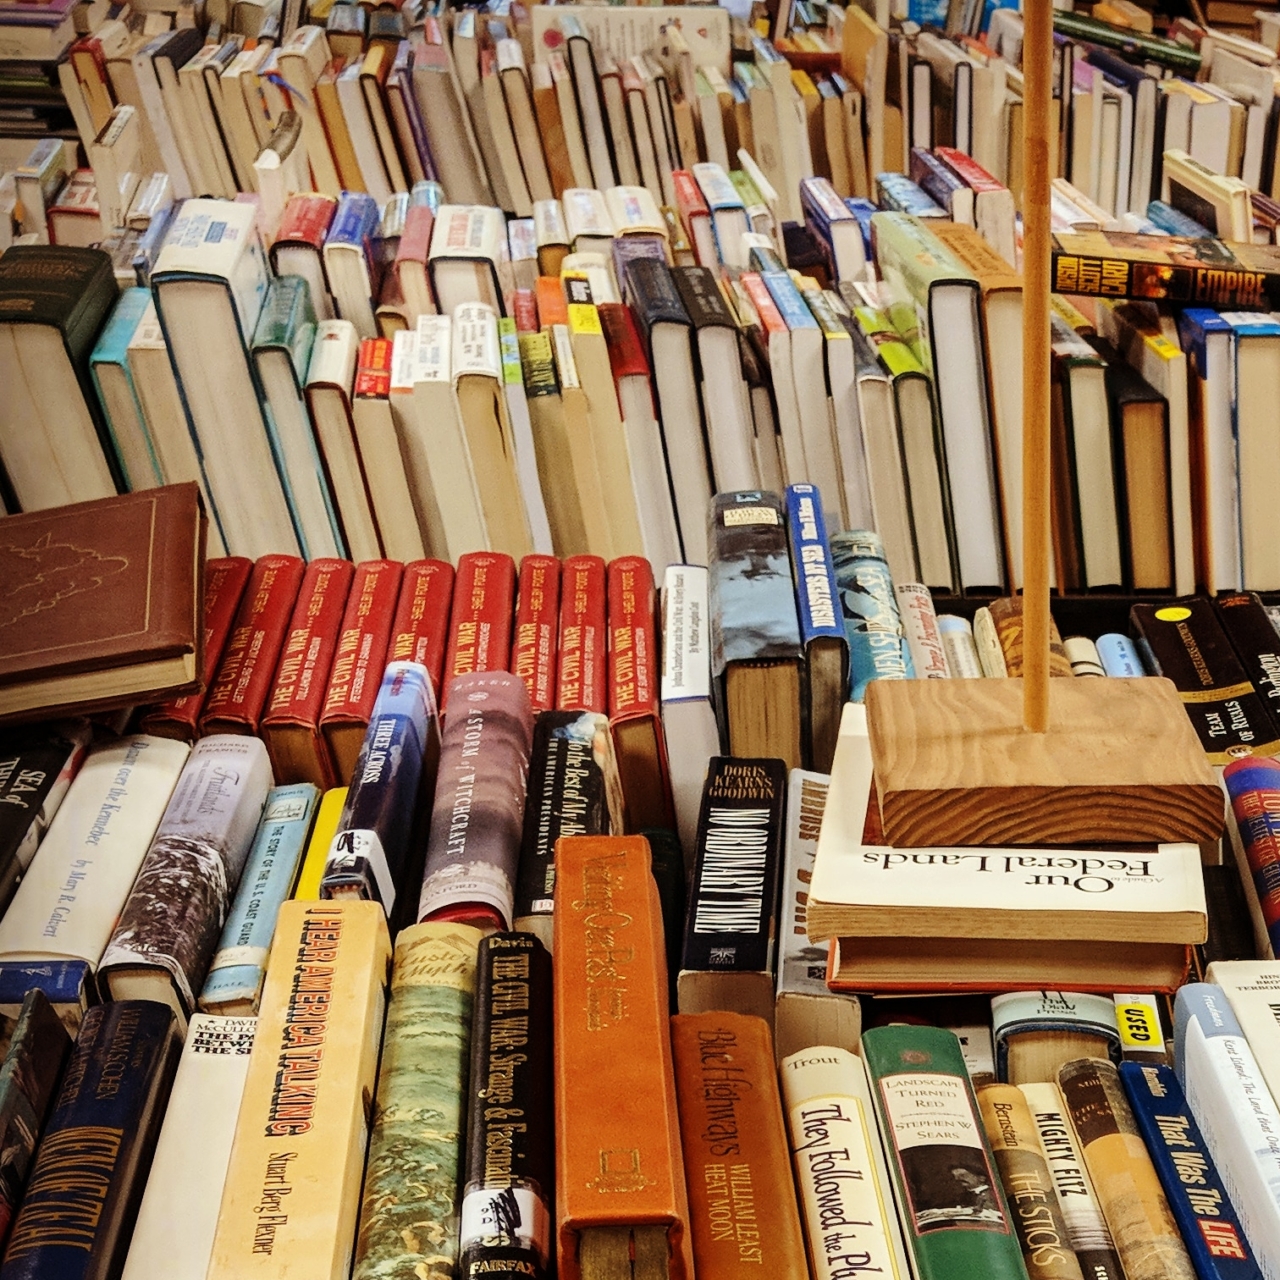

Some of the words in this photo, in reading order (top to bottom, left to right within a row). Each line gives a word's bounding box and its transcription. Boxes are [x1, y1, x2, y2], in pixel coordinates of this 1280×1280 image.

[1056, 256, 1078, 292] ORSON
[1078, 258, 1100, 294] SCOTT
[1101, 260, 1129, 296] CARD
[1196, 269, 1267, 305] EMPIRE
[563, 626, 582, 650] WAR
[561, 650, 581, 683] CIVIL
[560, 682, 580, 709] THE
[371, 718, 397, 751] THREE
[361, 748, 388, 784] ACROSS
[715, 776, 773, 787] KEARNS
[723, 765, 766, 777] DORIS
[708, 787, 775, 799] GOODWIN
[708, 807, 771, 826] NO
[699, 828, 769, 896] ORDINARY
[862, 852, 991, 873] Lands
[1004, 854, 1156, 877] Federal
[1025, 873, 1115, 894] Our
[693, 898, 763, 934] TIME
[297, 919, 343, 962] HEAR
[282, 965, 336, 1050] AMERICA
[1124, 1008, 1151, 1042] USED
[698, 1029, 738, 1064] Blue
[788, 1056, 841, 1071] Trout
[1222, 1039, 1237, 1058] Kent
[265, 1048, 325, 1137] TALKING
[886, 1077, 960, 1090] LANDSCAPE
[896, 1088, 957, 1099] TURNED
[1242, 1081, 1256, 1098] The
[702, 1063, 753, 1158] Highways
[915, 1099, 944, 1109] RED
[1249, 1096, 1265, 1117] Land
[793, 1104, 852, 1156] They
[917, 1130, 960, 1140] SEARS
[992, 1102, 1020, 1148] Bernstein
[1035, 1111, 1076, 1162] MIGHTY
[1154, 1114, 1196, 1149] That
[1255, 1114, 1271, 1134] that
[269, 1152, 299, 1188] Stuart
[704, 1164, 728, 1199] HEAT
[1053, 1167, 1088, 1198] FITZ
[1170, 1150, 1211, 1188] Was
[252, 1187, 293, 1214] Berg
[730, 1163, 758, 1219] WILLIAM
[803, 1147, 873, 1231] Followed
[1186, 1187, 1224, 1217] The
[251, 1212, 288, 1257] Flexner
[708, 1200, 735, 1242] MOON
[738, 1218, 763, 1264] LEAST
[823, 1231, 851, 1254] the
[1199, 1219, 1247, 1260] LIFE
[469, 1259, 537, 1277] FAIRFAX
